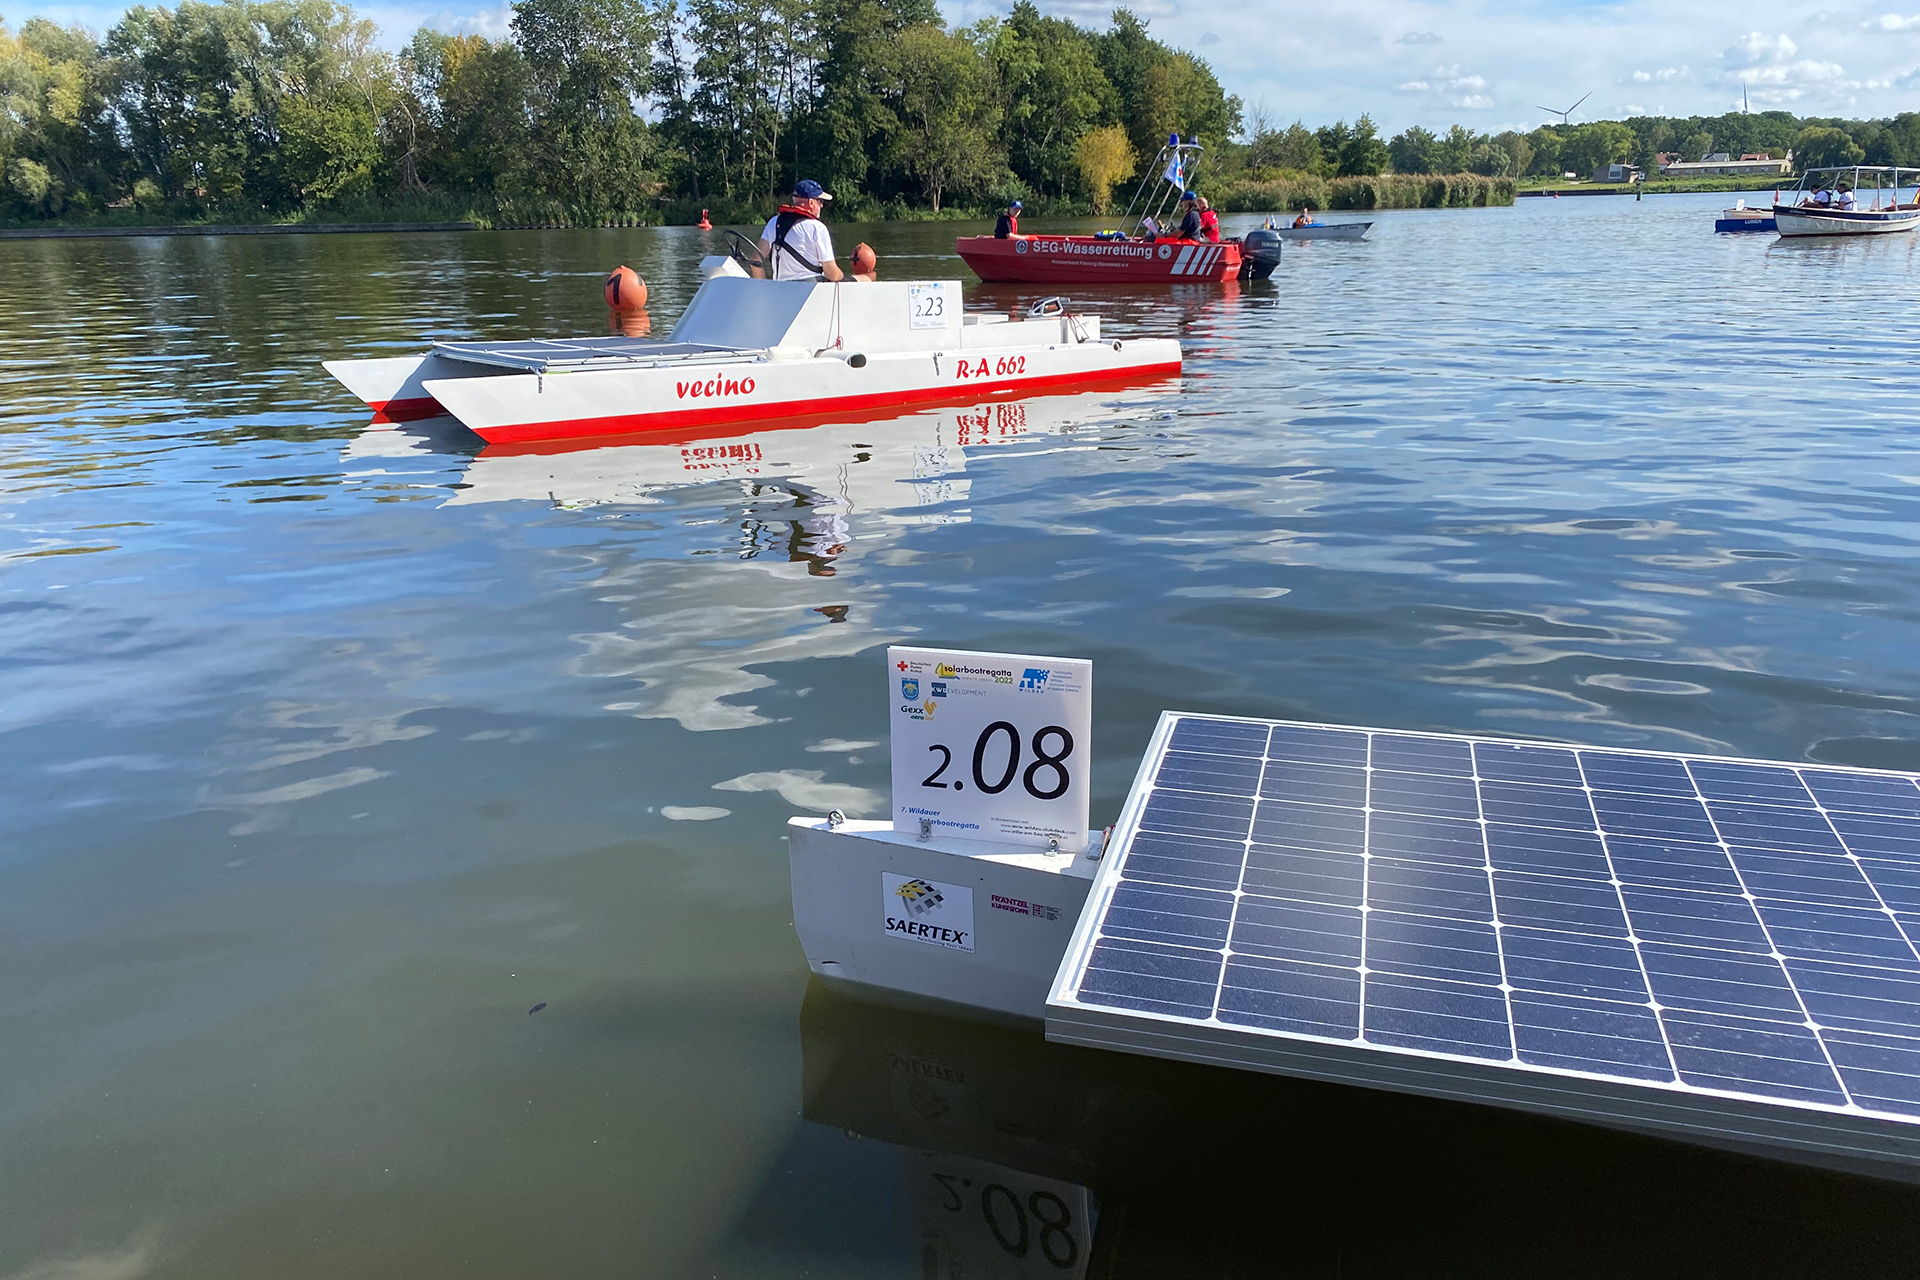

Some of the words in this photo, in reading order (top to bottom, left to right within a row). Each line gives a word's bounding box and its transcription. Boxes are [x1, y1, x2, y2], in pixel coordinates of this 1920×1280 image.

[1033, 241, 1153, 260] SEG-Wasserrettung
[915, 296, 943, 317] 2.23
[996, 356, 1026, 375] 662
[676, 373, 755, 399] vecino
[944, 665, 1012, 677] solarbootregatta
[994, 676, 1013, 684] 2022
[901, 705, 924, 714] Gexx
[922, 721, 1074, 800] 2.08
[908, 807, 941, 816] Wildauer
[885, 917, 965, 945] SAERTEX
